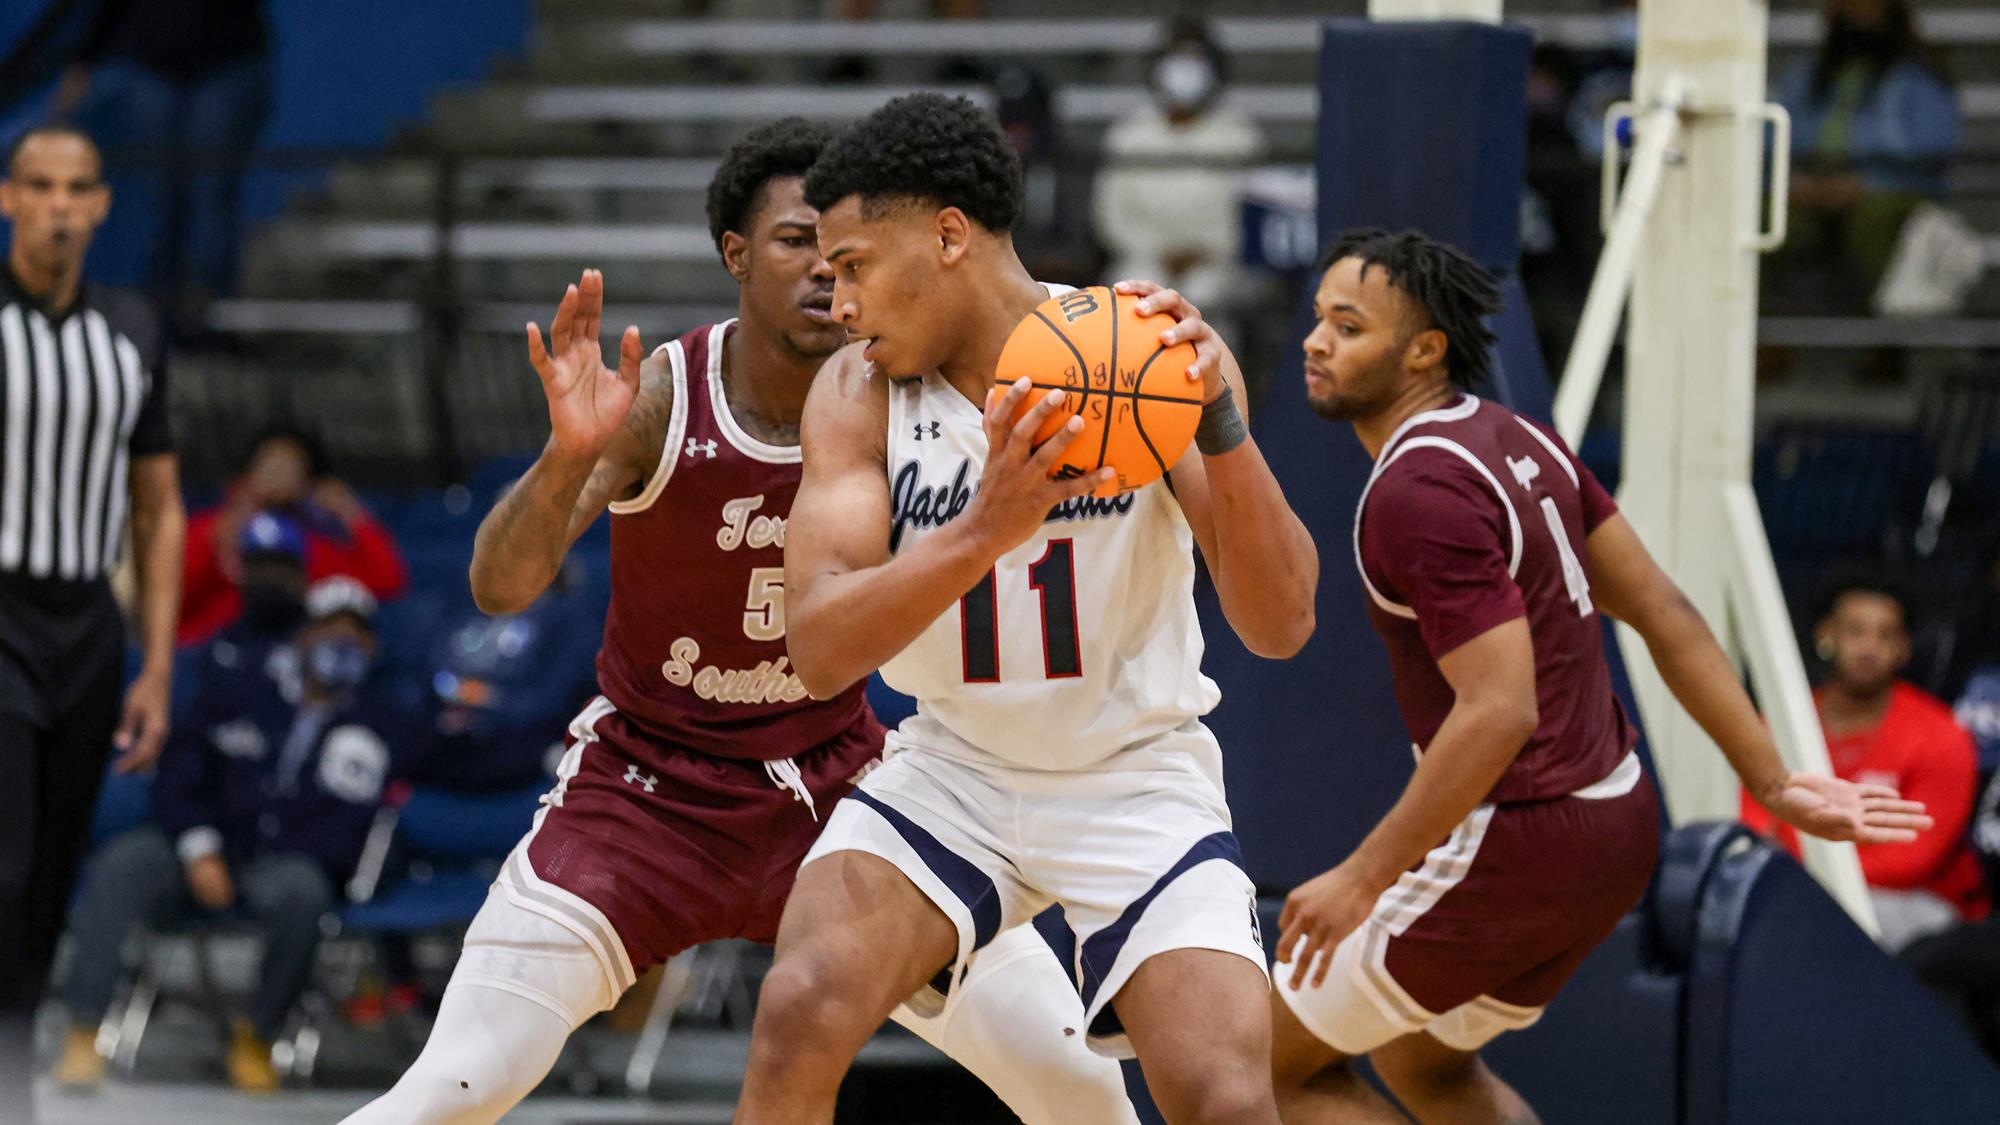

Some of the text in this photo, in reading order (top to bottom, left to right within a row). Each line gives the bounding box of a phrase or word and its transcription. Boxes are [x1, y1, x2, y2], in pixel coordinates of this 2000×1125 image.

[716, 494, 788, 552] Tex
[888, 458, 981, 557] Jack
[1539, 496, 1594, 619] 4
[742, 568, 787, 641] 5
[960, 537, 1083, 683] 11
[661, 636, 812, 704] Southe
